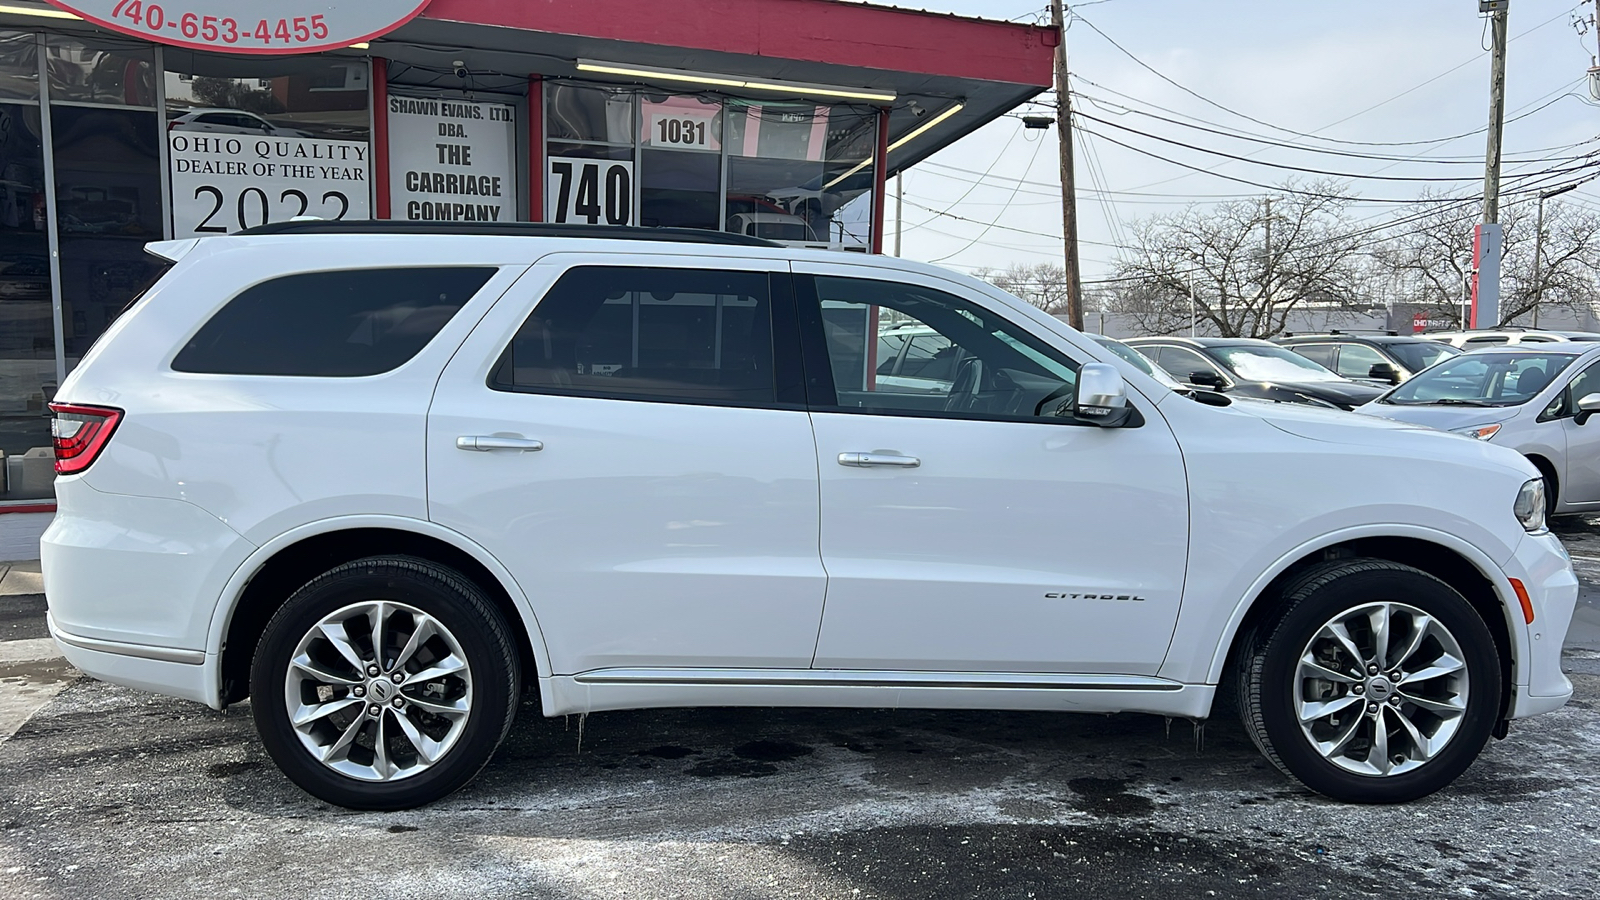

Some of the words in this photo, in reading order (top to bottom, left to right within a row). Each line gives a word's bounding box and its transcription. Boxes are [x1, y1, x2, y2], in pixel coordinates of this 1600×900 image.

[111, 0, 329, 44] 740-653-4455
[390, 98, 438, 116] SHAWN
[489, 107, 514, 122] LTD.
[438, 122, 468, 138] DBA.
[657, 118, 706, 145] 1031
[172, 136, 242, 155] OHIO
[254, 140, 367, 161] QUALITY
[435, 143, 472, 166] THE
[175, 158, 249, 176] DEALER
[252, 162, 276, 177] OF
[280, 164, 316, 178] THE
[319, 166, 365, 181] YEAR
[405, 171, 502, 197] CARRIAGE
[551, 161, 630, 225] 740
[193, 185, 349, 234] 2022
[407, 200, 501, 222] COMPANY
[1044, 592, 1145, 602] CITADEL
